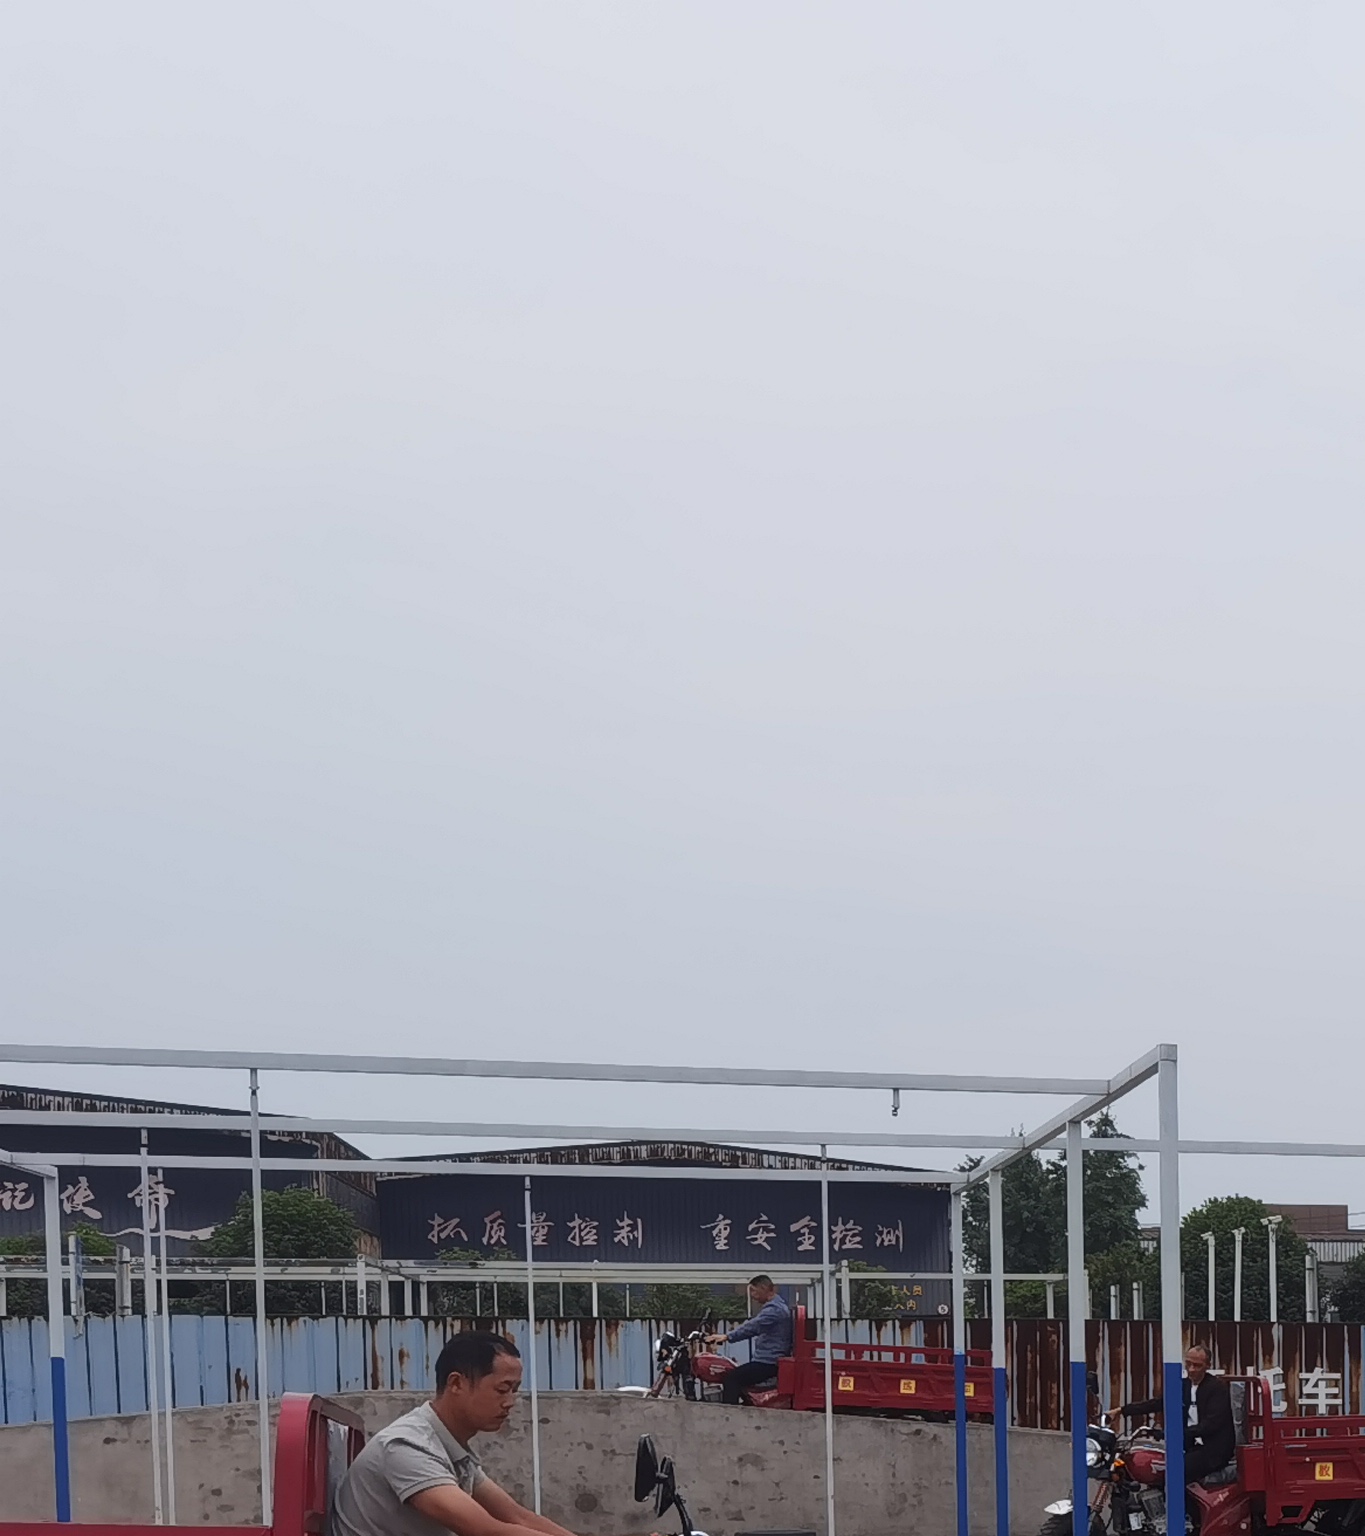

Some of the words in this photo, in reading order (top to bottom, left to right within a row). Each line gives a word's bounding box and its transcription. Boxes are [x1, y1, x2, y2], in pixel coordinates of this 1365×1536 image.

[700, 1213, 904, 1252] 重安全检测
[1318, 1464, 1331, 1477] 教
